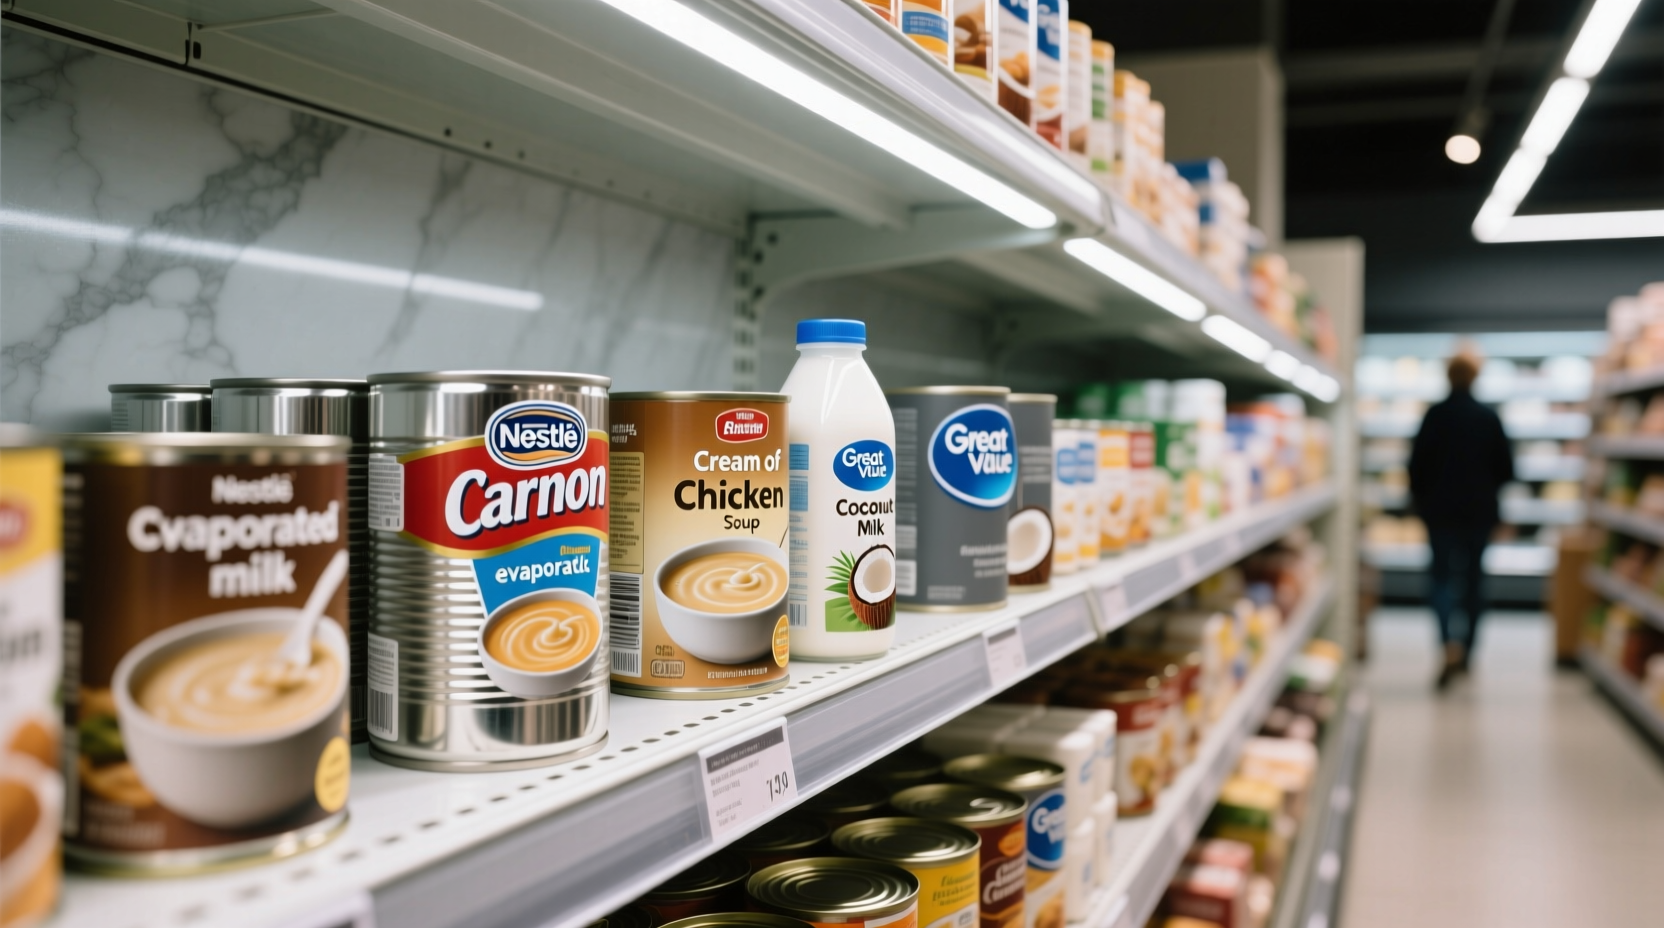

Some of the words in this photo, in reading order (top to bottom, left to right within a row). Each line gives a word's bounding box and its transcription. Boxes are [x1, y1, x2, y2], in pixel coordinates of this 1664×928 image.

[944, 423, 1008, 455] Great
[693, 450, 760, 472] Cream
[764, 448, 782, 472] of
[842, 447, 884, 467] Great
[445, 464, 607, 537] Carnon
[674, 479, 784, 511] Chicken
[724, 515, 760, 534] Soup
[857, 518, 885, 537] Milk
[208, 549, 297, 598] milk
